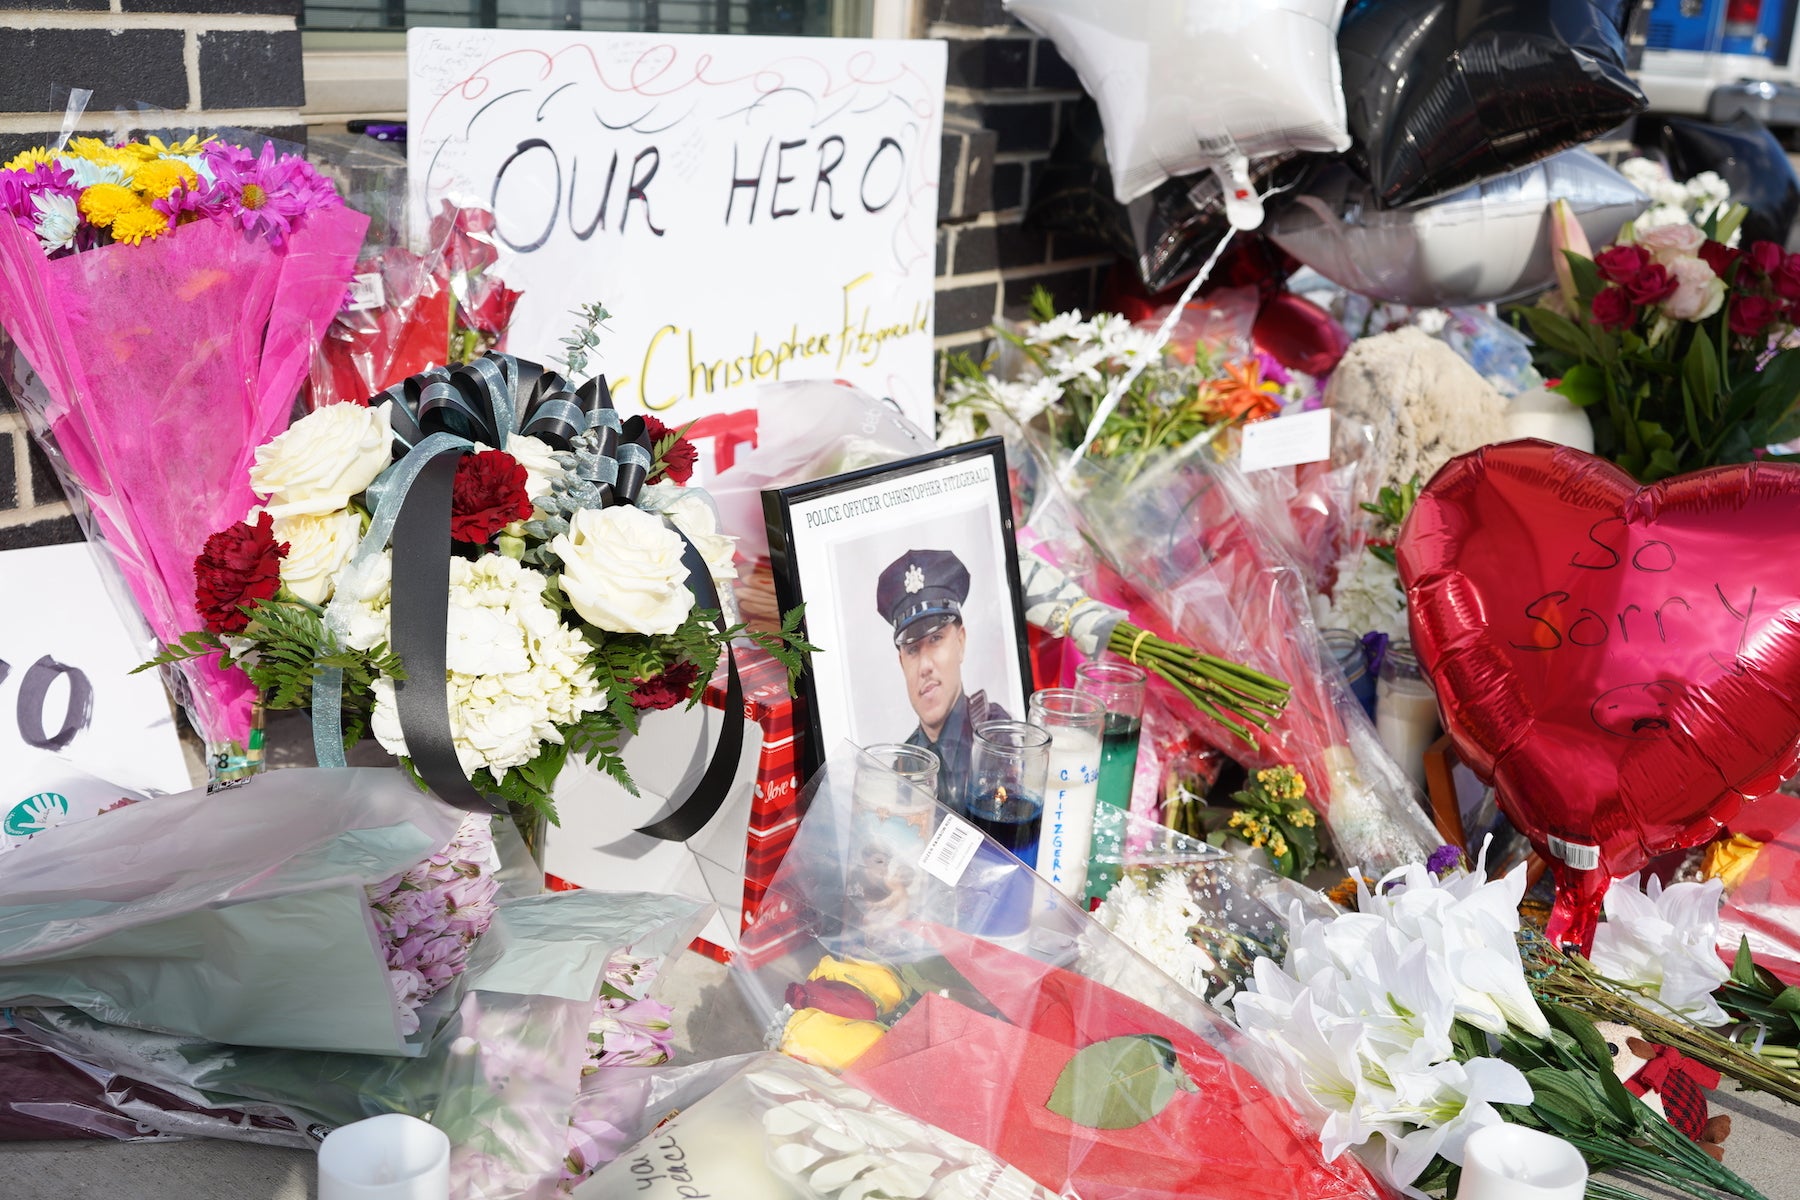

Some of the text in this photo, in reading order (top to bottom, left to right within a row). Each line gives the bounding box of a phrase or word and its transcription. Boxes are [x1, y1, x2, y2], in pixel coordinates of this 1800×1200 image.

[491, 138, 665, 254] OUR
[726, 135, 905, 226] HERO
[638, 324, 831, 411] Christopher
[806, 467, 991, 528] POLICE OFFICER CHRISTOPHER FITZGERALD
[1568, 516, 1676, 573] So
[764, 780, 790, 803] love
